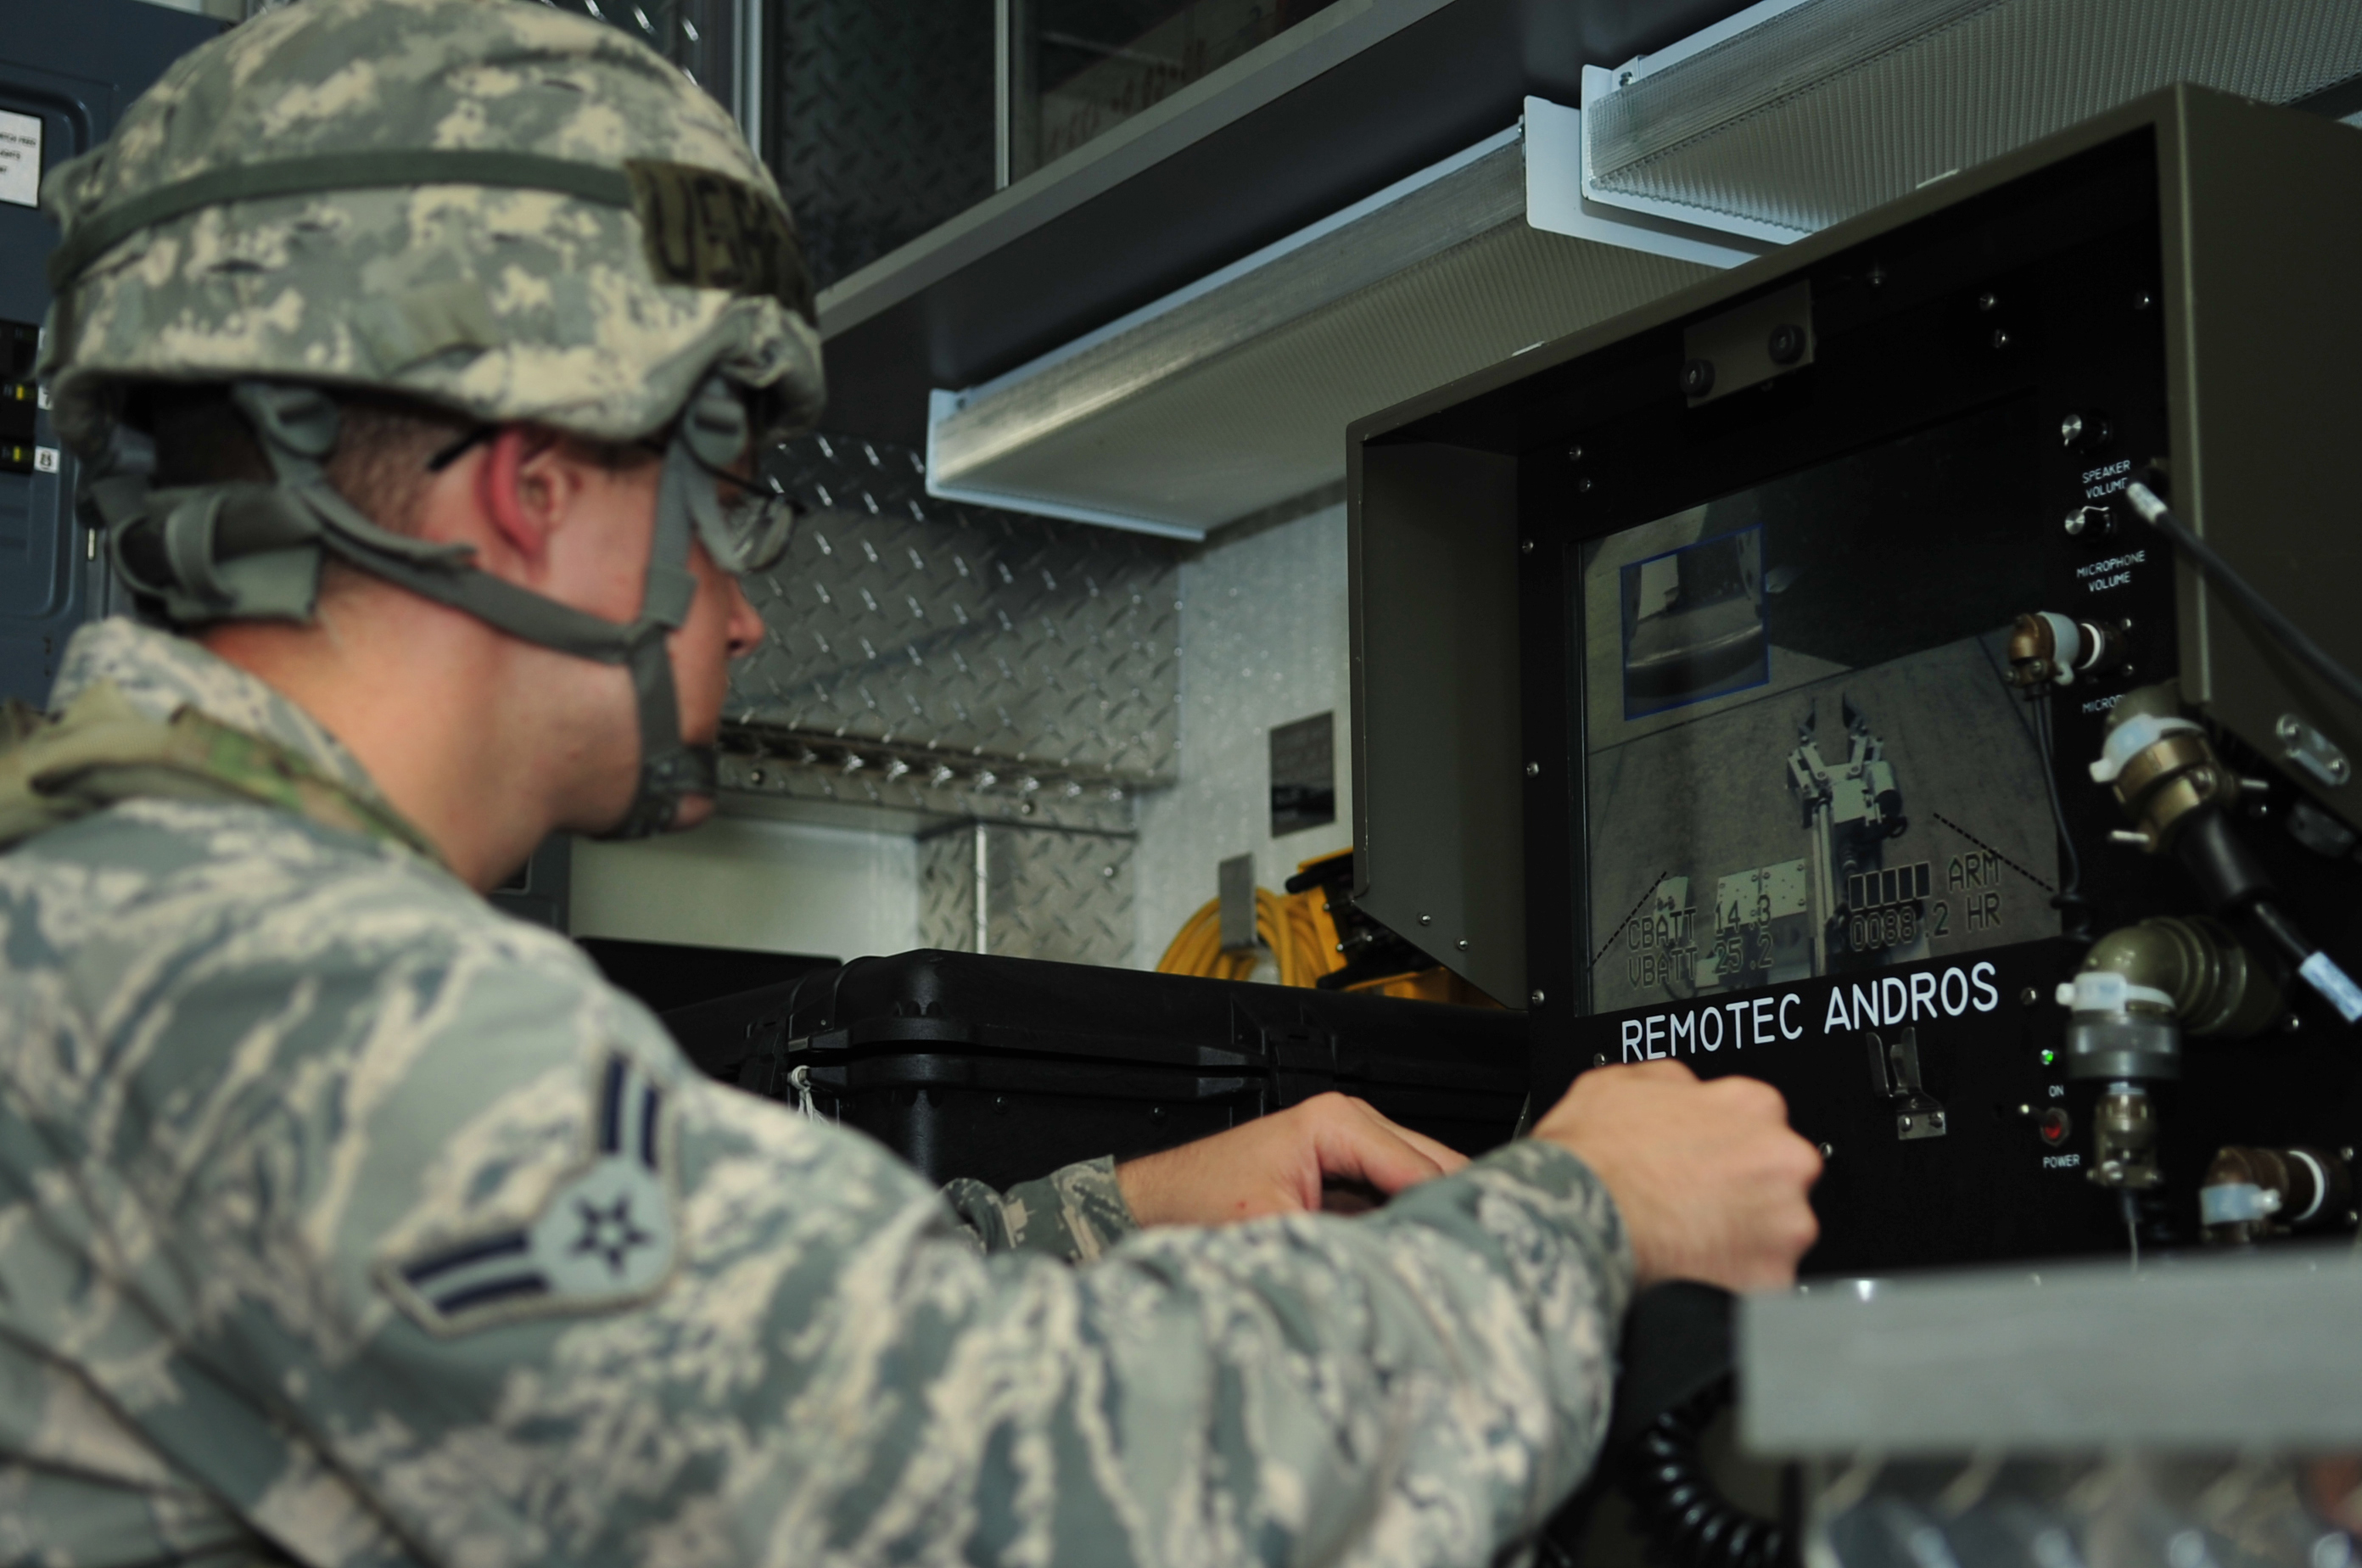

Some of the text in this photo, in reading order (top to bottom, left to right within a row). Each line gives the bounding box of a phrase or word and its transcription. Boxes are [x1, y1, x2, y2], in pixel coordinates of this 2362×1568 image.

[2082, 459, 2130, 484] SPEAKER
[2076, 550, 2146, 579] MICROPHONE
[2087, 571, 2131, 592] VOLUME
[1949, 850, 2001, 893] ARM
[1626, 906, 1697, 951] CBATT
[1715, 894, 1772, 937] 14.3
[1966, 893, 2001, 932] HR
[1627, 933, 1773, 989] VBATT 25.2
[1621, 961, 1999, 1064] REMOTEC ANDROS
[2049, 1085, 2064, 1098] ON
[2043, 1154, 2080, 1168] POWER
